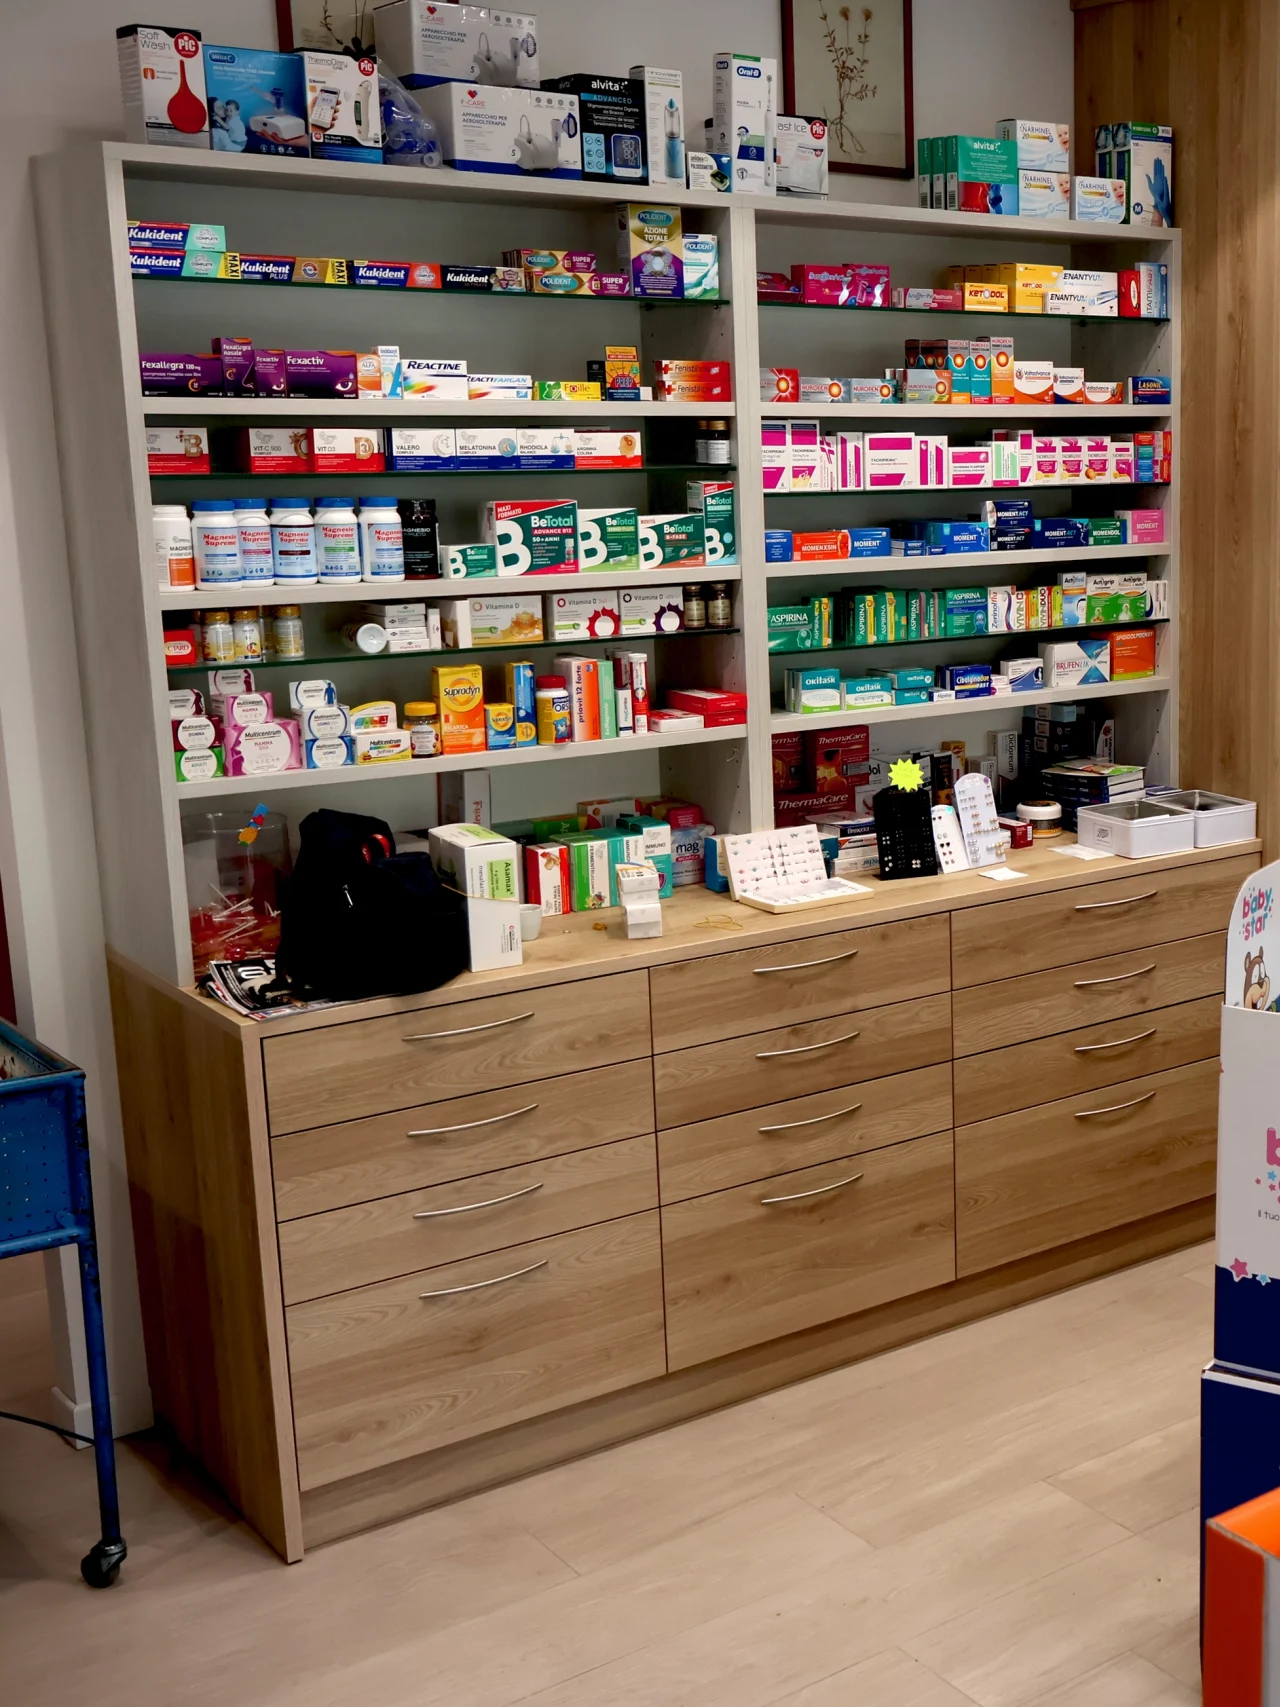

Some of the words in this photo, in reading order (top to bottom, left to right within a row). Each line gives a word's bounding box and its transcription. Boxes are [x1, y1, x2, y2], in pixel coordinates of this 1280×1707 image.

[139, 30, 159, 41] Soft
[421, 28, 457, 36] APPARECCHIO
[140, 39, 171, 51] Wash
[591, 80, 620, 91] alvita
[593, 95, 632, 104] ADVANCED
[462, 112, 498, 120] APPARECCHIO
[973, 141, 994, 151] alvita
[1134, 204, 1142, 213] M
[639, 212, 667, 221] POLIDENT
[129, 228, 183, 241] Kukident
[644, 234, 668, 242] TOTALE
[686, 242, 712, 250] POLIDENT
[130, 255, 182, 267] Kukident
[228, 254, 239, 278] MAXI
[241, 262, 290, 274] Kukident
[336, 260, 346, 283] MAXI
[358, 267, 405, 279] Kukident
[446, 272, 488, 284] Kukident
[542, 276, 572, 285] POLIDENT
[142, 361, 184, 371] Fexallegra
[287, 356, 324, 366] Fexactiv
[406, 360, 462, 372] REACTINE
[1024, 370, 1051, 378] Voltadvance
[615, 377, 632, 388] PREP
[1138, 381, 1163, 389] LASONIL
[498, 509, 522, 519] FORMATO
[531, 515, 573, 527] BeTotal
[606, 517, 635, 525] BeTotal
[664, 524, 693, 533] BeTotal
[953, 592, 981, 600] ASPIRINA
[771, 613, 808, 623] ASPIRINA
[1016, 601, 1024, 628] VIVIN
[443, 685, 481, 697] Supradyn
[491, 715, 512, 724] Supradyn
[245, 730, 282, 739] Multicentrum
[818, 732, 867, 745] ThermaCare
[370, 738, 402, 747] Multicentrum
[778, 793, 848, 810] ThermaCare
[676, 841, 700, 854] mag
[1242, 887, 1272, 919] baby
[1244, 912, 1268, 941] star
[1264, 1211, 1280, 1223] tuo
